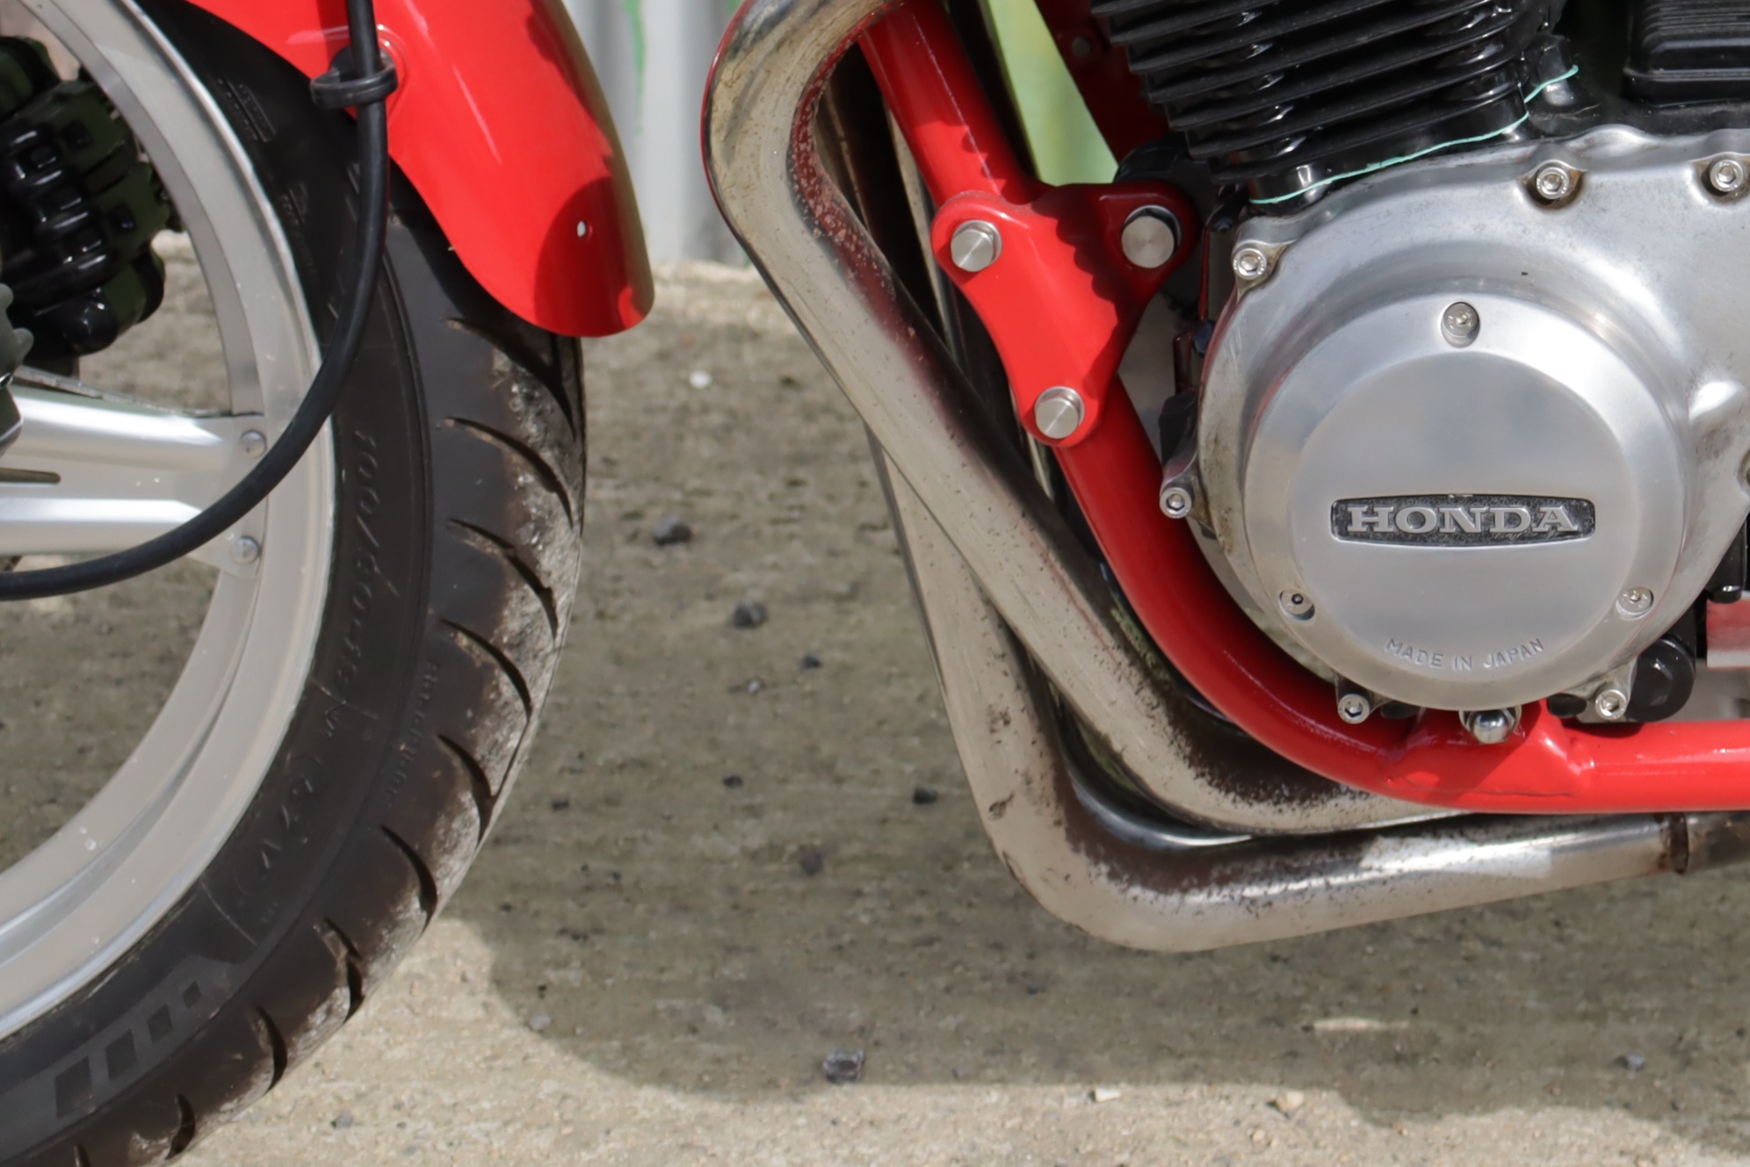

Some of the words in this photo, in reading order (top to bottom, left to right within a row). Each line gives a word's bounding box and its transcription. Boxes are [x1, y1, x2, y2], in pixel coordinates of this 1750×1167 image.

[1346, 505, 1579, 534] HONDA
[1386, 637, 1444, 668] MADE
[1453, 655, 1473, 671] IN
[1483, 637, 1544, 669] JAPAN
